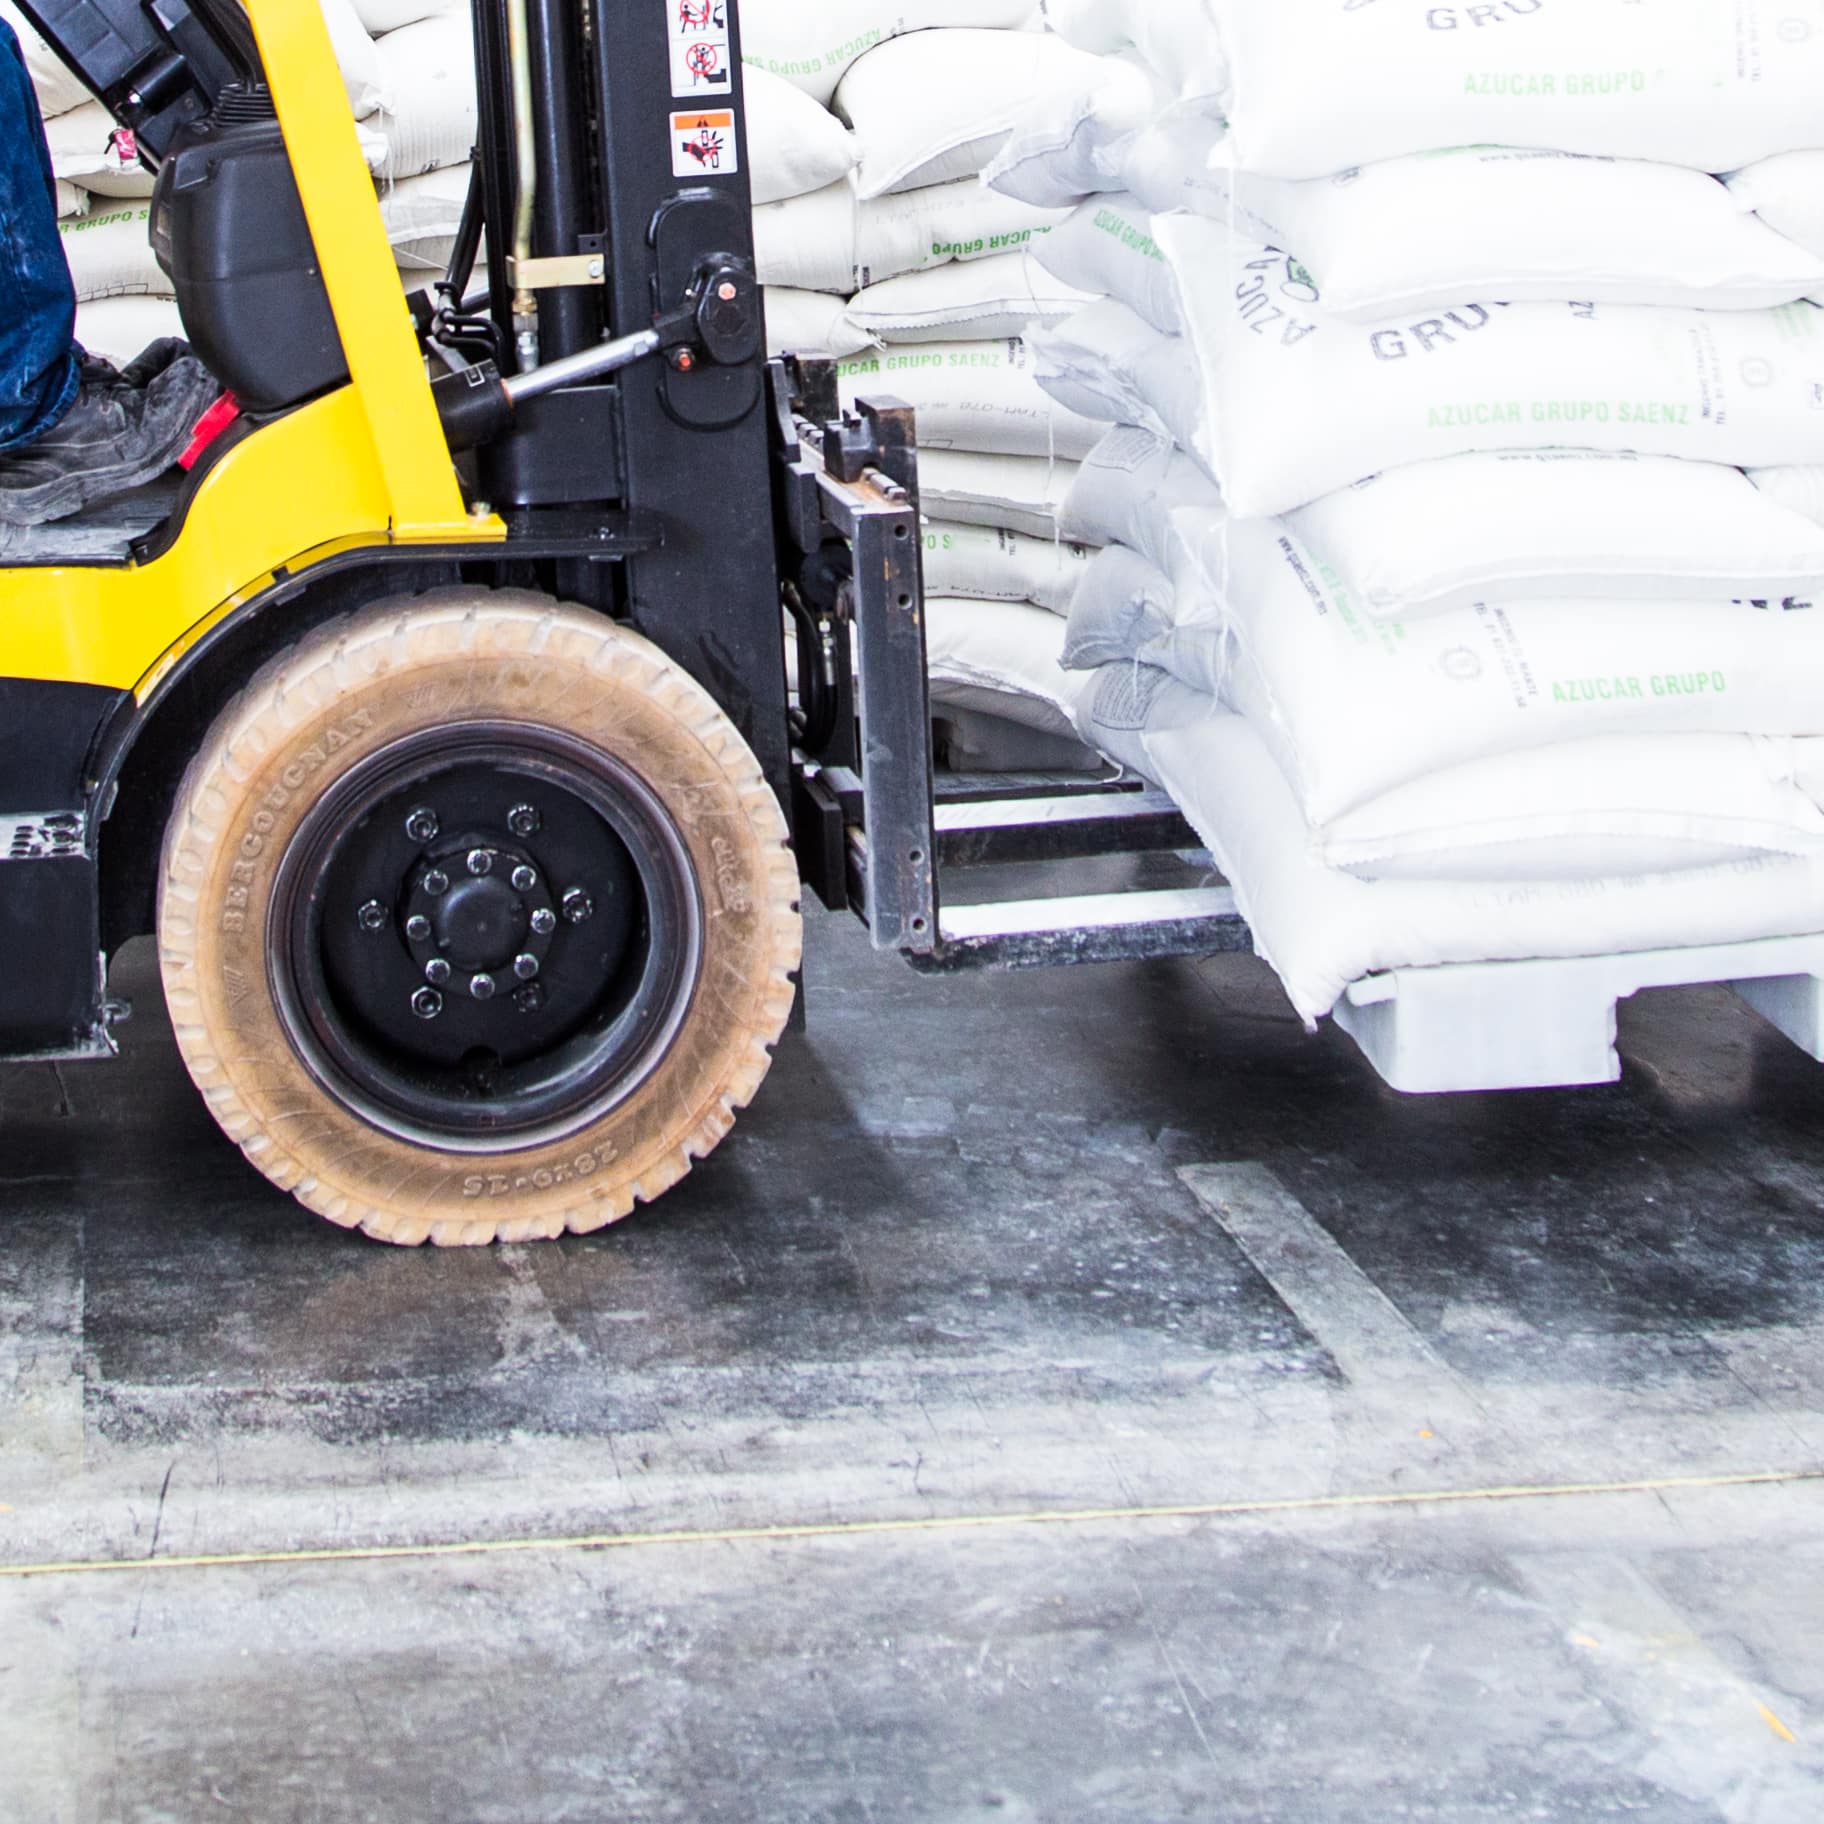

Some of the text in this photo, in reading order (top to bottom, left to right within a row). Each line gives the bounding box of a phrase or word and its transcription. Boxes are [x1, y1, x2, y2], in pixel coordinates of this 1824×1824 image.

[825, 28, 882, 66] AZUCAR
[768, 58, 822, 75] GRUPO
[1463, 68, 1647, 95] AZUCAR GRUPO
[887, 353, 943, 371] GRUPO
[948, 352, 1002, 369] SAENZ
[1427, 401, 1690, 428] AZUCAR GRUPO SAENZ
[1552, 670, 1727, 703] AZUCAR GRUPO
